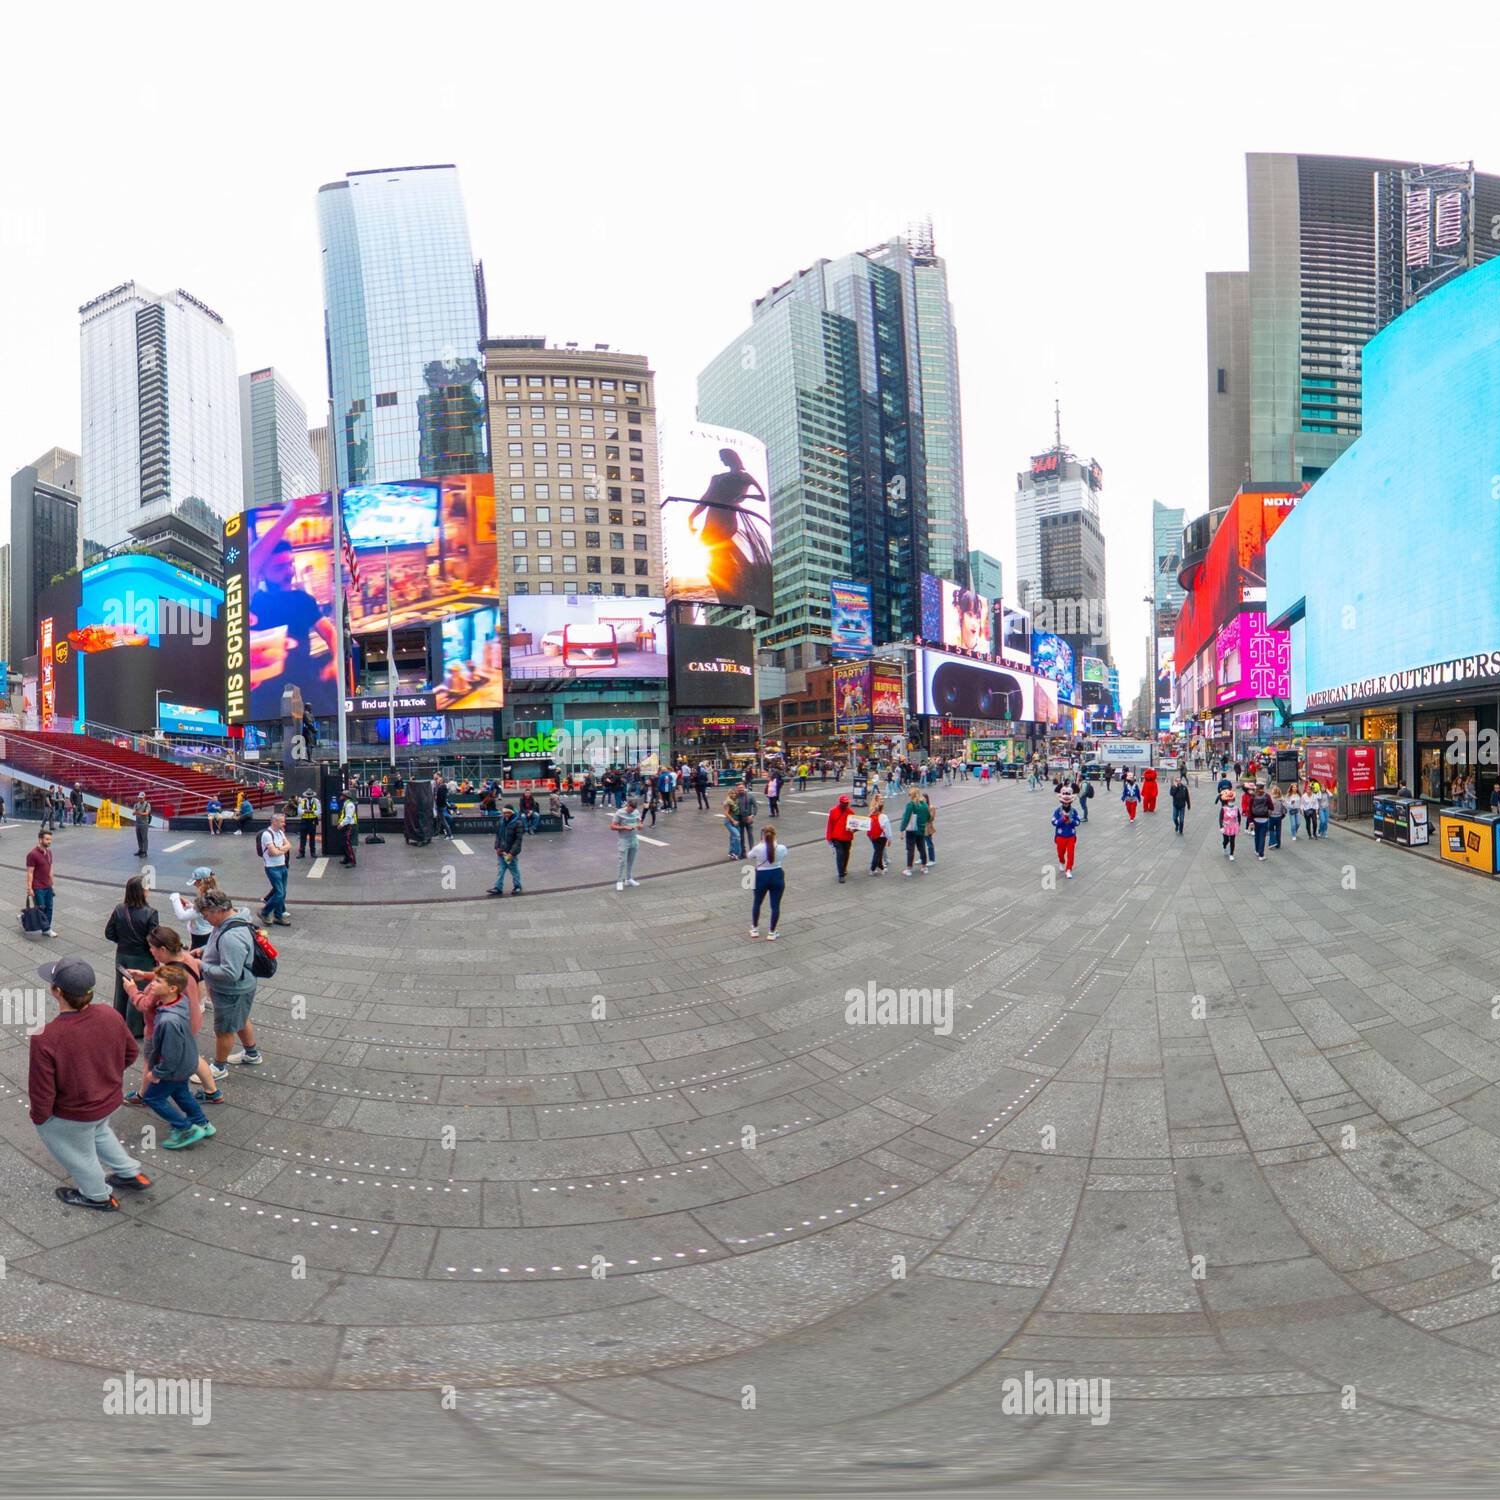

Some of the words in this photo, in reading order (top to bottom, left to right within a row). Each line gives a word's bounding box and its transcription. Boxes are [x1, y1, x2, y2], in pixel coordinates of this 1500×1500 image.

[1406, 212, 1430, 265] AMERICAN
[1436, 192, 1461, 247] OUTFITTERS
[227, 574, 243, 670] SCREEN
[688, 662, 718, 672] CASA
[720, 663, 739, 673] DEL
[739, 665, 752, 675] SOL
[361, 700, 377, 709] find
[399, 699, 426, 708] TikTok
[1306, 684, 1349, 708] AMERICAN
[1351, 676, 1387, 700] EAGLE
